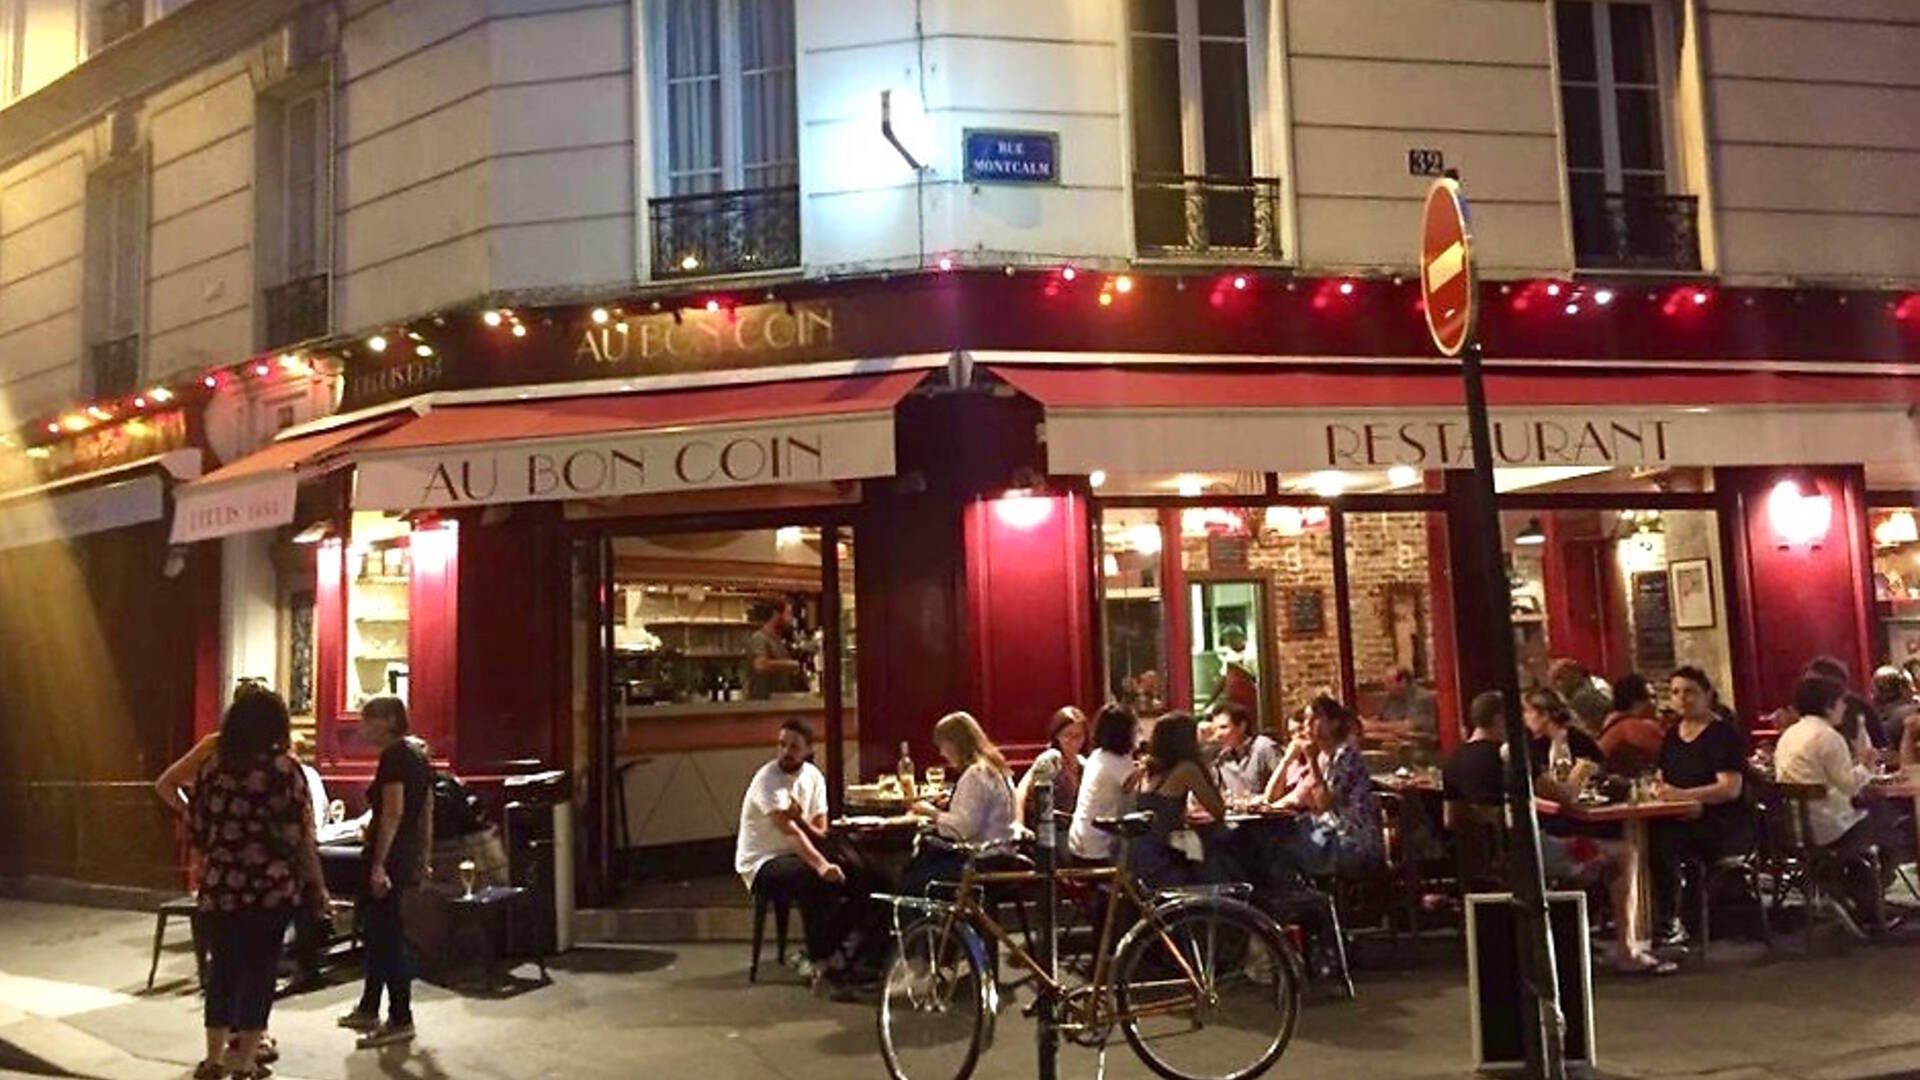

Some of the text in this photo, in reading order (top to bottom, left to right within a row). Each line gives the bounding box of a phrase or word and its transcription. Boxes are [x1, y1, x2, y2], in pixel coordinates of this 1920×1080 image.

[997, 141, 1025, 155] RUE
[973, 159, 1050, 175] MONTCALM
[575, 324, 628, 364] AU
[735, 308, 834, 351] COIN
[420, 433, 823, 504] AU BON COIN
